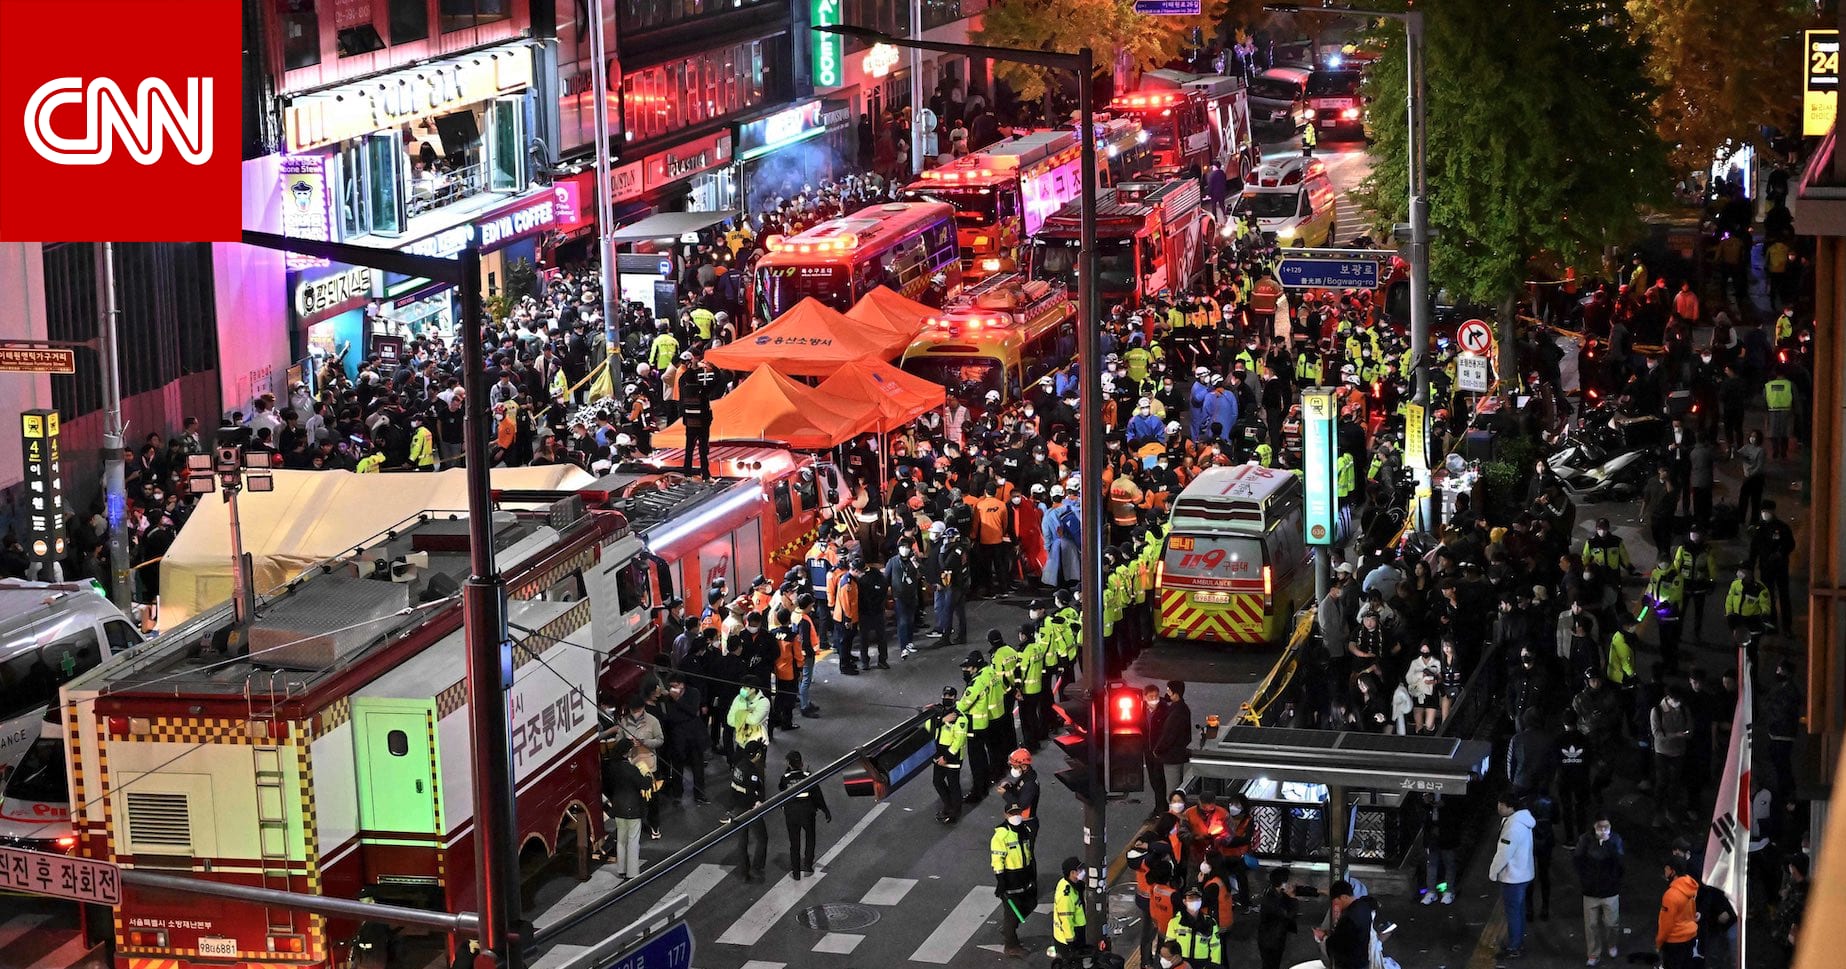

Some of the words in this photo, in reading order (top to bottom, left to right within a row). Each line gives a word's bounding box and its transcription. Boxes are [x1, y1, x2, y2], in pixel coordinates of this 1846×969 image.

[482, 214, 516, 245] EDIYA
[514, 199, 553, 234] COFFEE
[1340, 265, 1374, 275] 보광로
[774, 336, 832, 346] 용산소방서
[30, 440, 39, 454] 4
[52, 438, 58, 451] 4
[1179, 549, 1227, 570] 119
[1192, 578, 1232, 587] AMBULANCE
[1417, 780, 1443, 791] 용산구
[0, 853, 29, 887] 직진
[36, 857, 53, 890] 후
[61, 863, 116, 900] 좌회전
[129, 918, 166, 928] 서울특별시
[168, 920, 212, 930] 소방재난본부
[667, 942, 687, 968] 177
